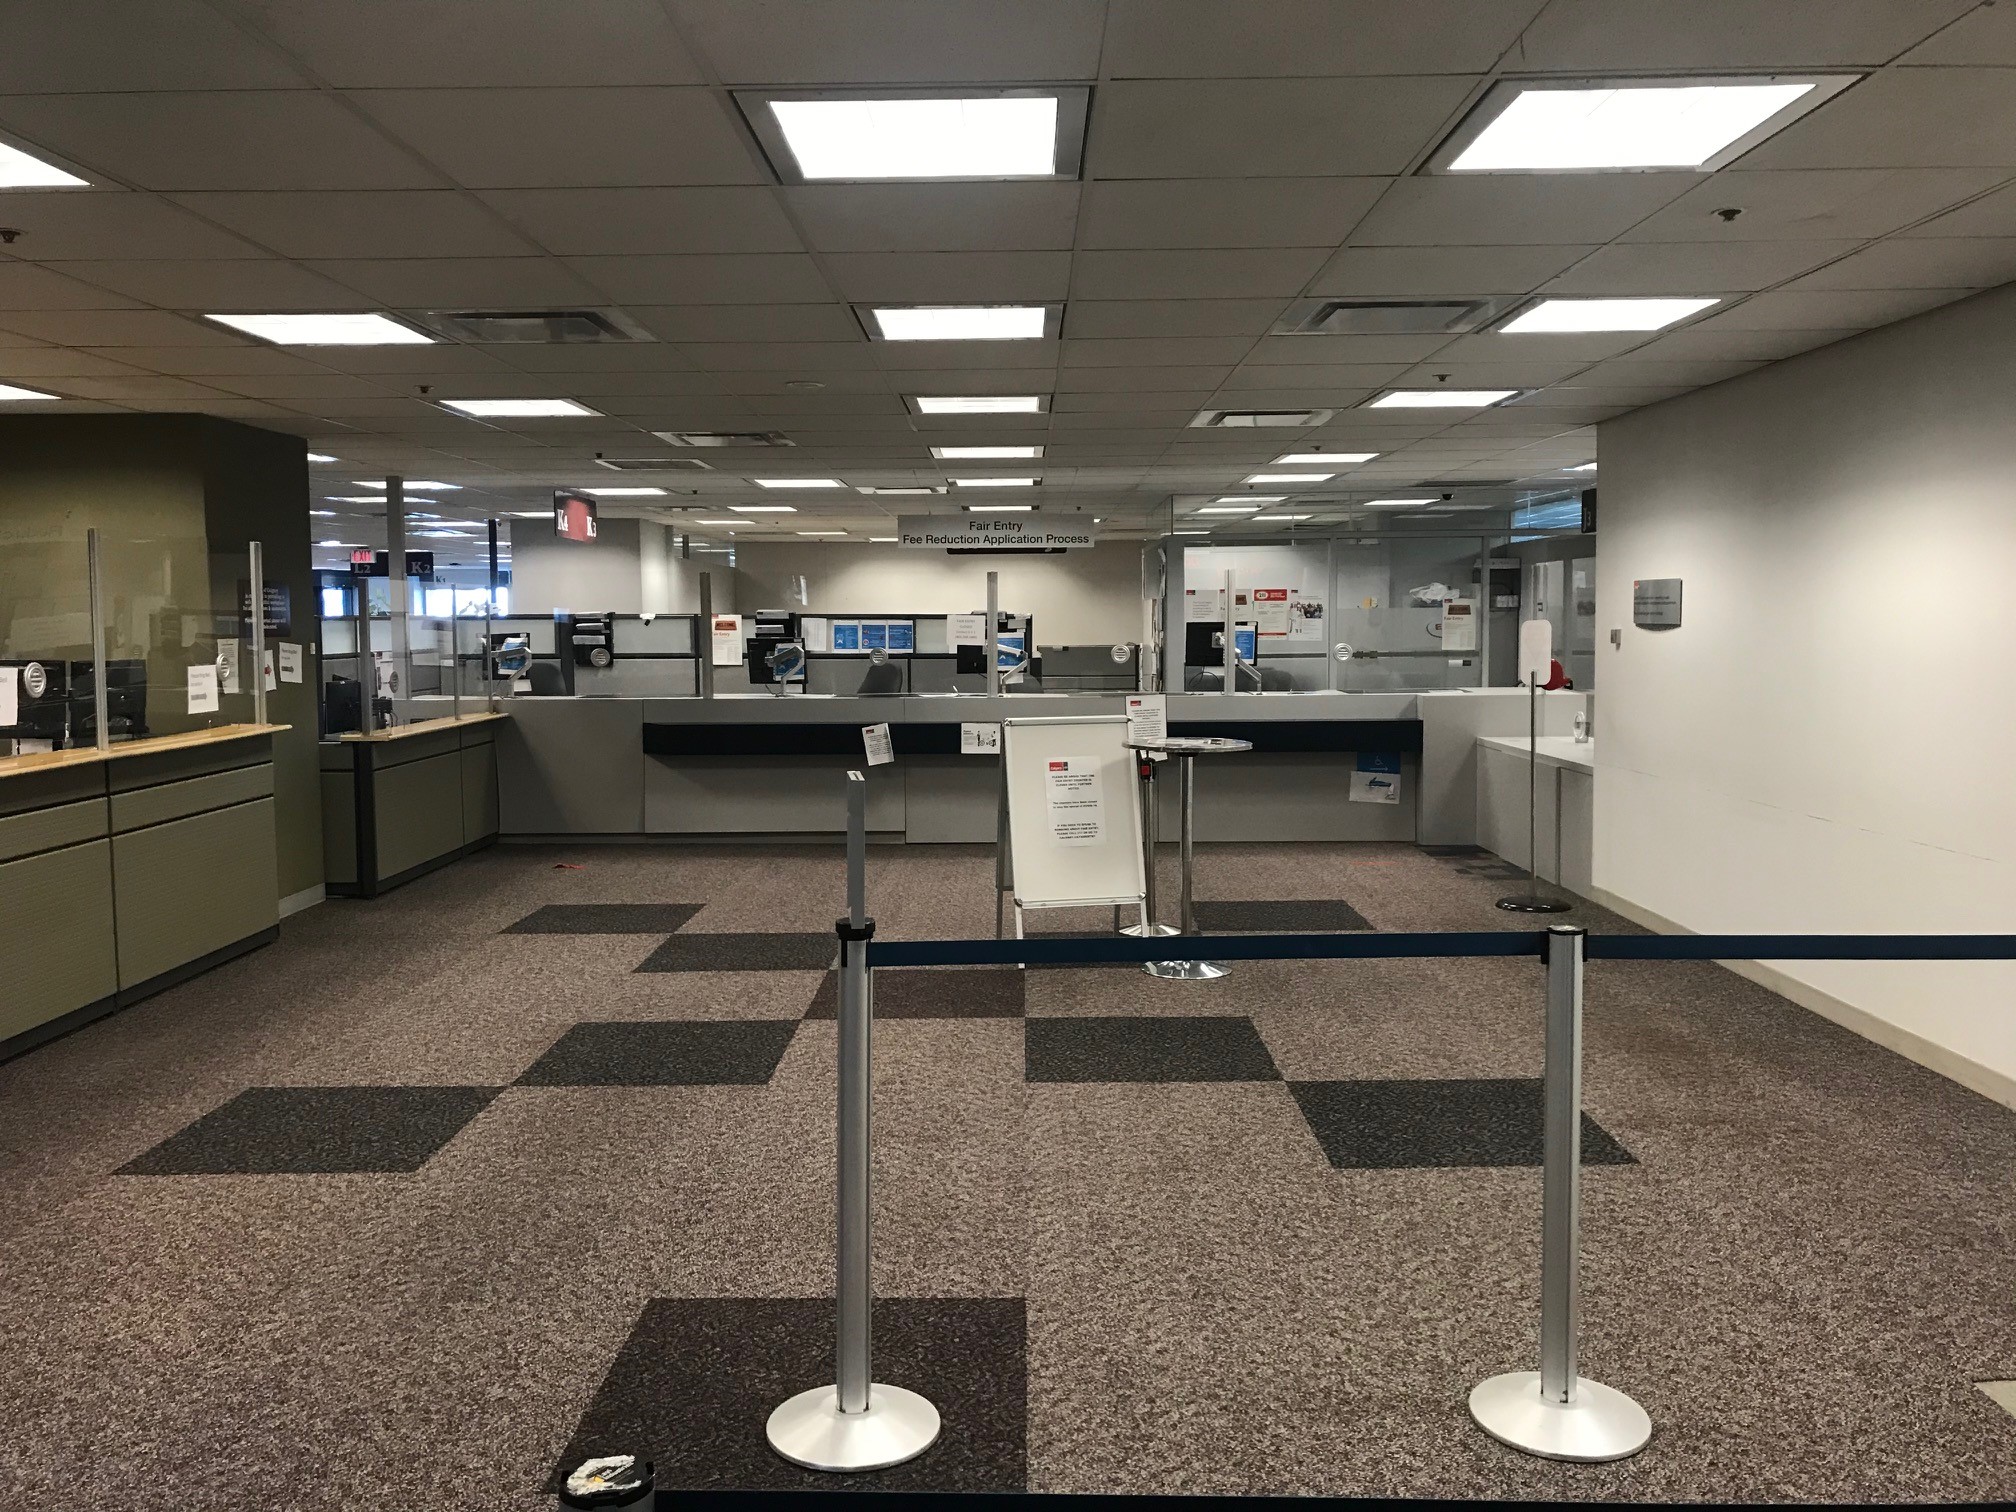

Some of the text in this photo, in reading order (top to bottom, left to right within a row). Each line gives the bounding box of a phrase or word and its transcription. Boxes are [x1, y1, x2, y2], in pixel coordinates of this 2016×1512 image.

[557, 509, 569, 532] K4
[586, 515, 597, 538] K3
[969, 521, 1023, 533] Fair Entry
[903, 533, 1090, 547] Fee Reduction Application Process
[353, 549, 372, 562] EXIT
[354, 562, 371, 574] L2
[410, 561, 431, 574] K2
